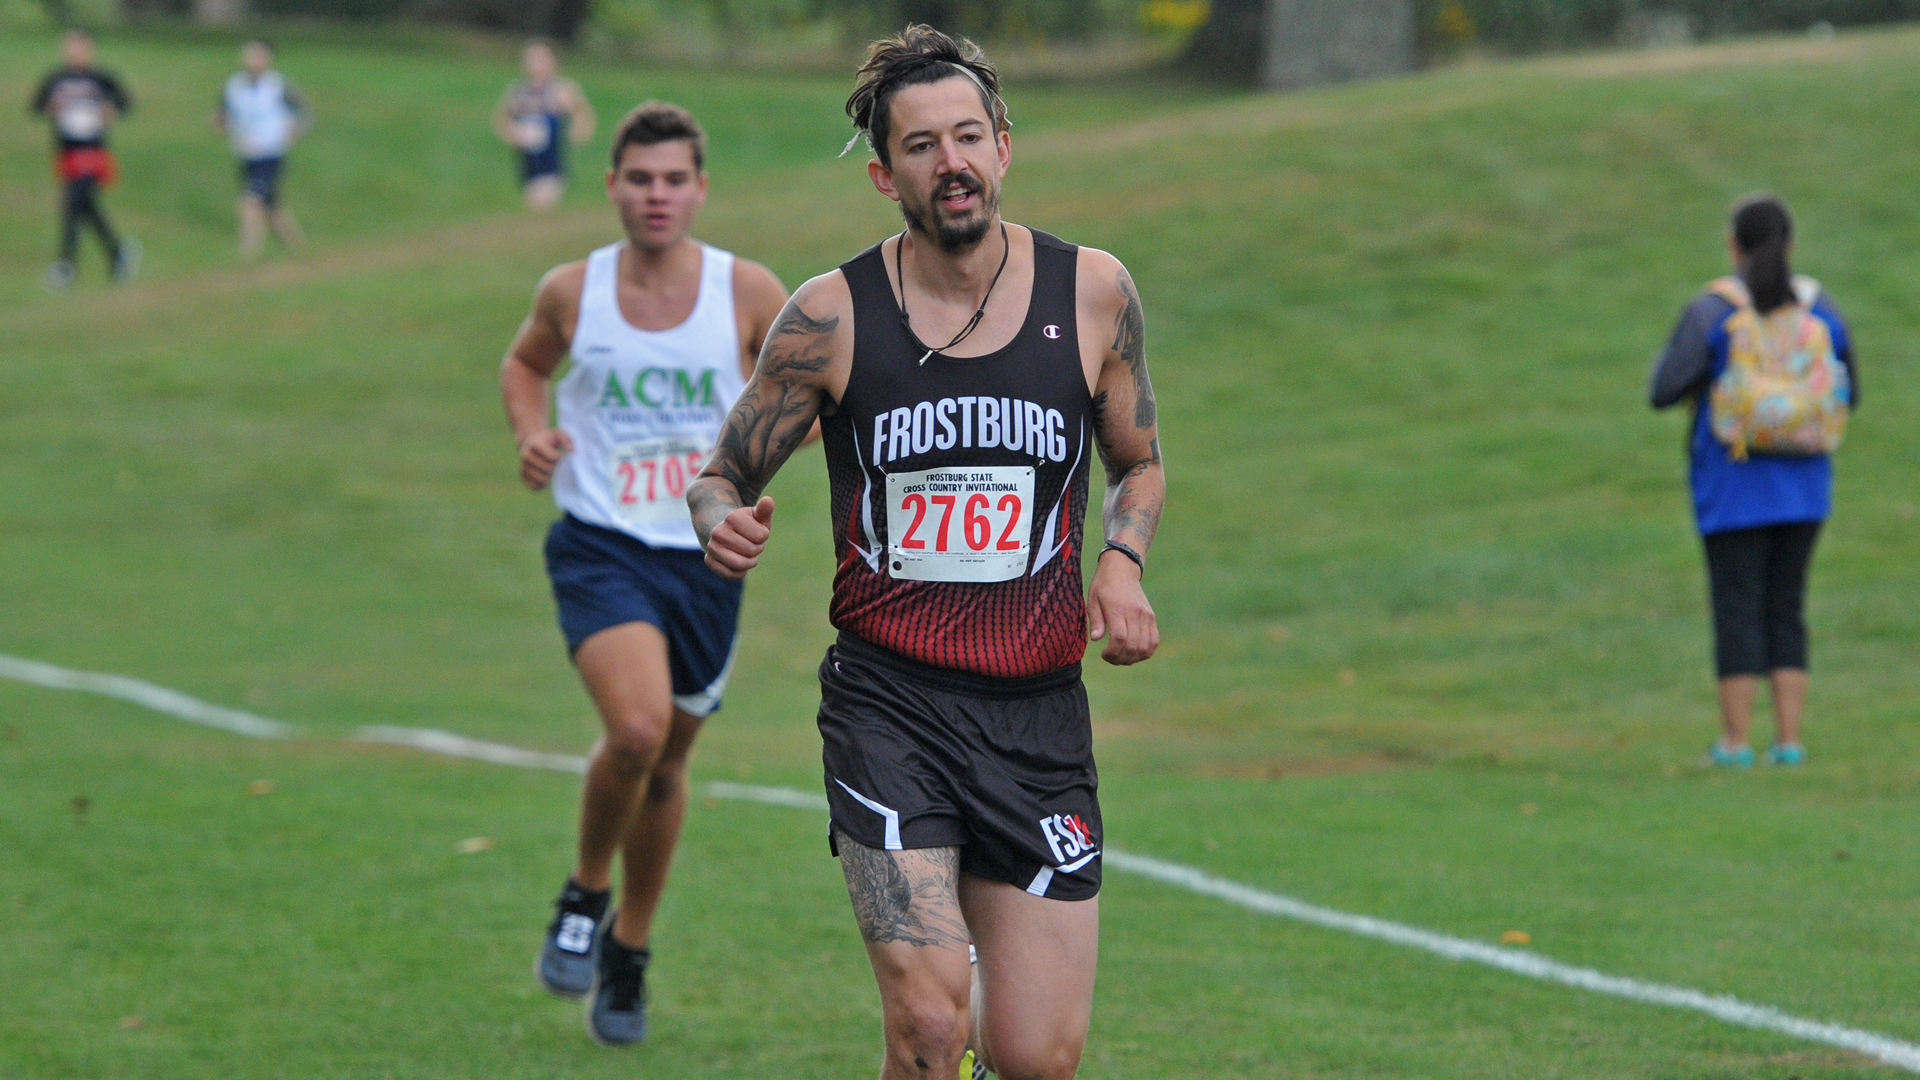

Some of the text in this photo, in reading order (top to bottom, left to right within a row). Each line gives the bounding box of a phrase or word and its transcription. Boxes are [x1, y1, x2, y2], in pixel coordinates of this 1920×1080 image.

[599, 366, 717, 409] ACM
[873, 396, 1067, 466] FROSTBURG
[903, 483, 1018, 493] CROSS COUNTRY INVITATIONAL
[926, 473, 993, 482] FROSTBURG STATE
[901, 493, 1022, 551] 2762
